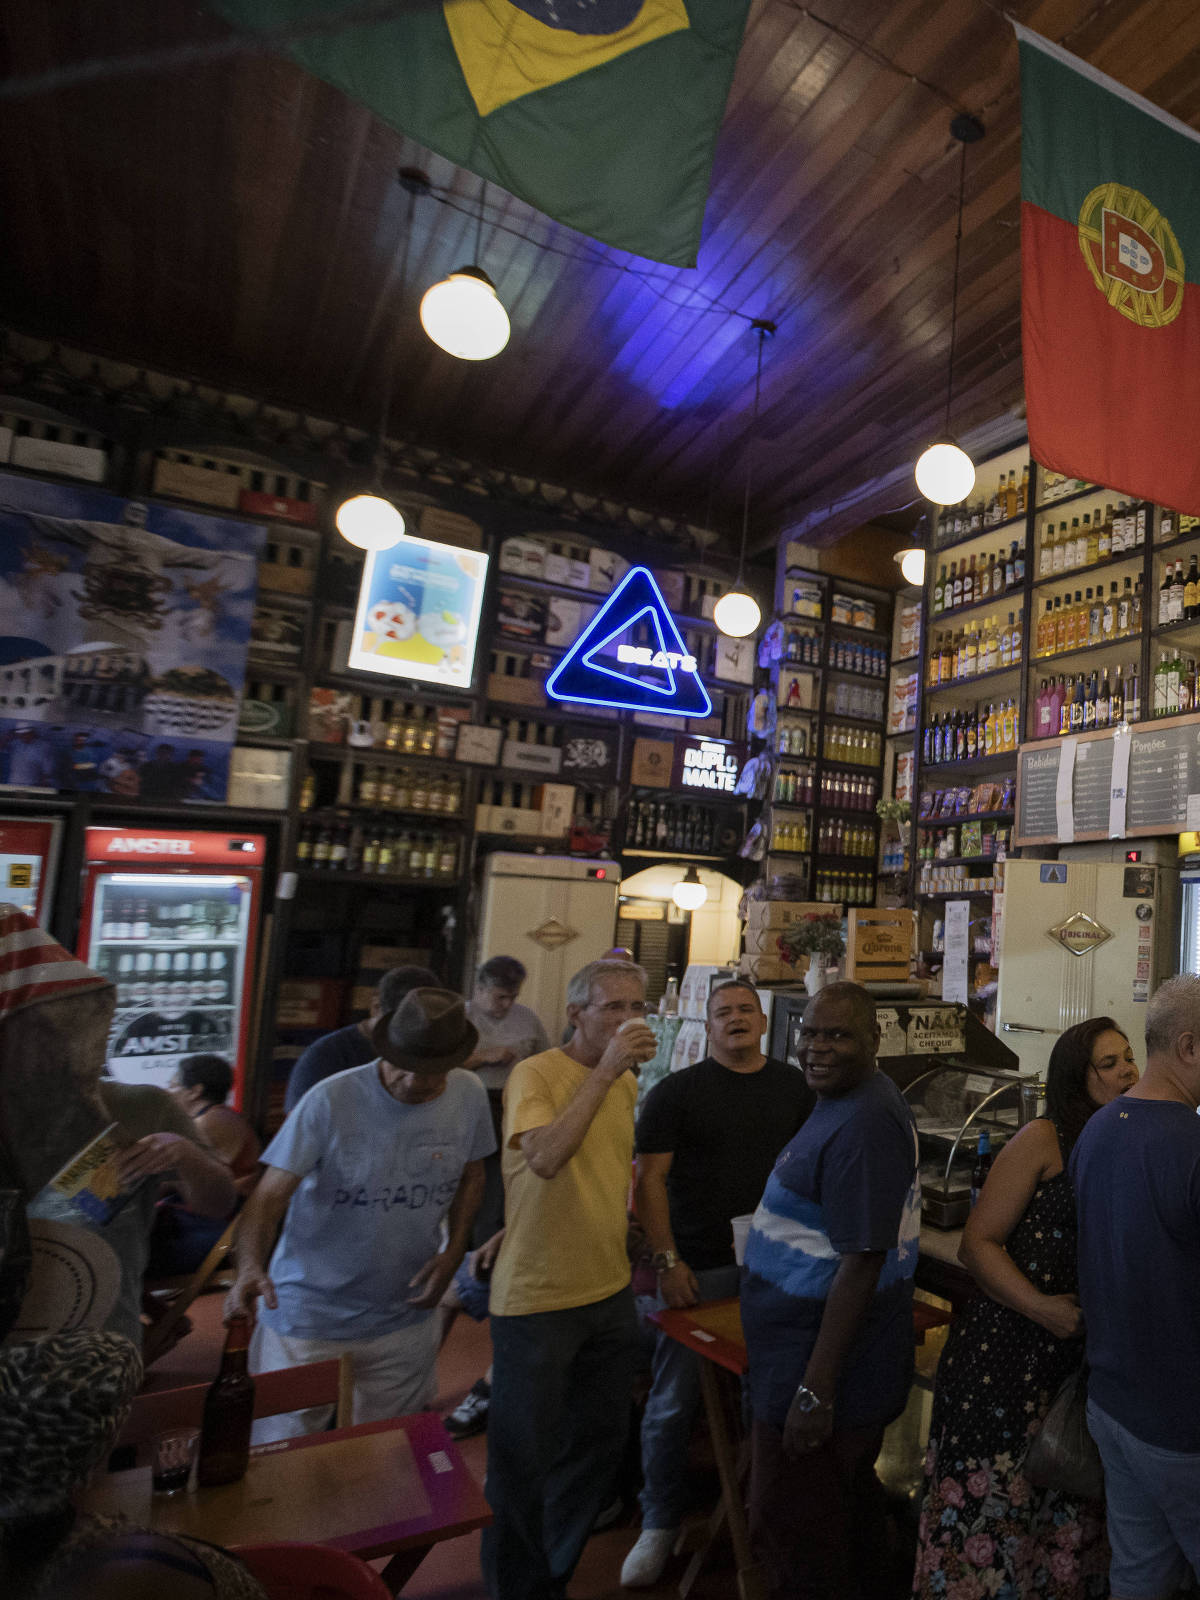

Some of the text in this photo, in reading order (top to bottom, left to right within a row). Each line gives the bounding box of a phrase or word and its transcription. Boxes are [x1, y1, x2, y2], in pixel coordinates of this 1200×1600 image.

[617, 644, 697, 673] BEATS
[1132, 738, 1166, 753] Porções
[684, 748, 738, 773] DUPLO
[682, 767, 737, 792] MALTE
[107, 837, 195, 855] AMSTEL
[1060, 929, 1101, 940] ORIGINAL
[862, 942, 903, 955] Corona
[919, 1039, 952, 1048] CHEQUE
